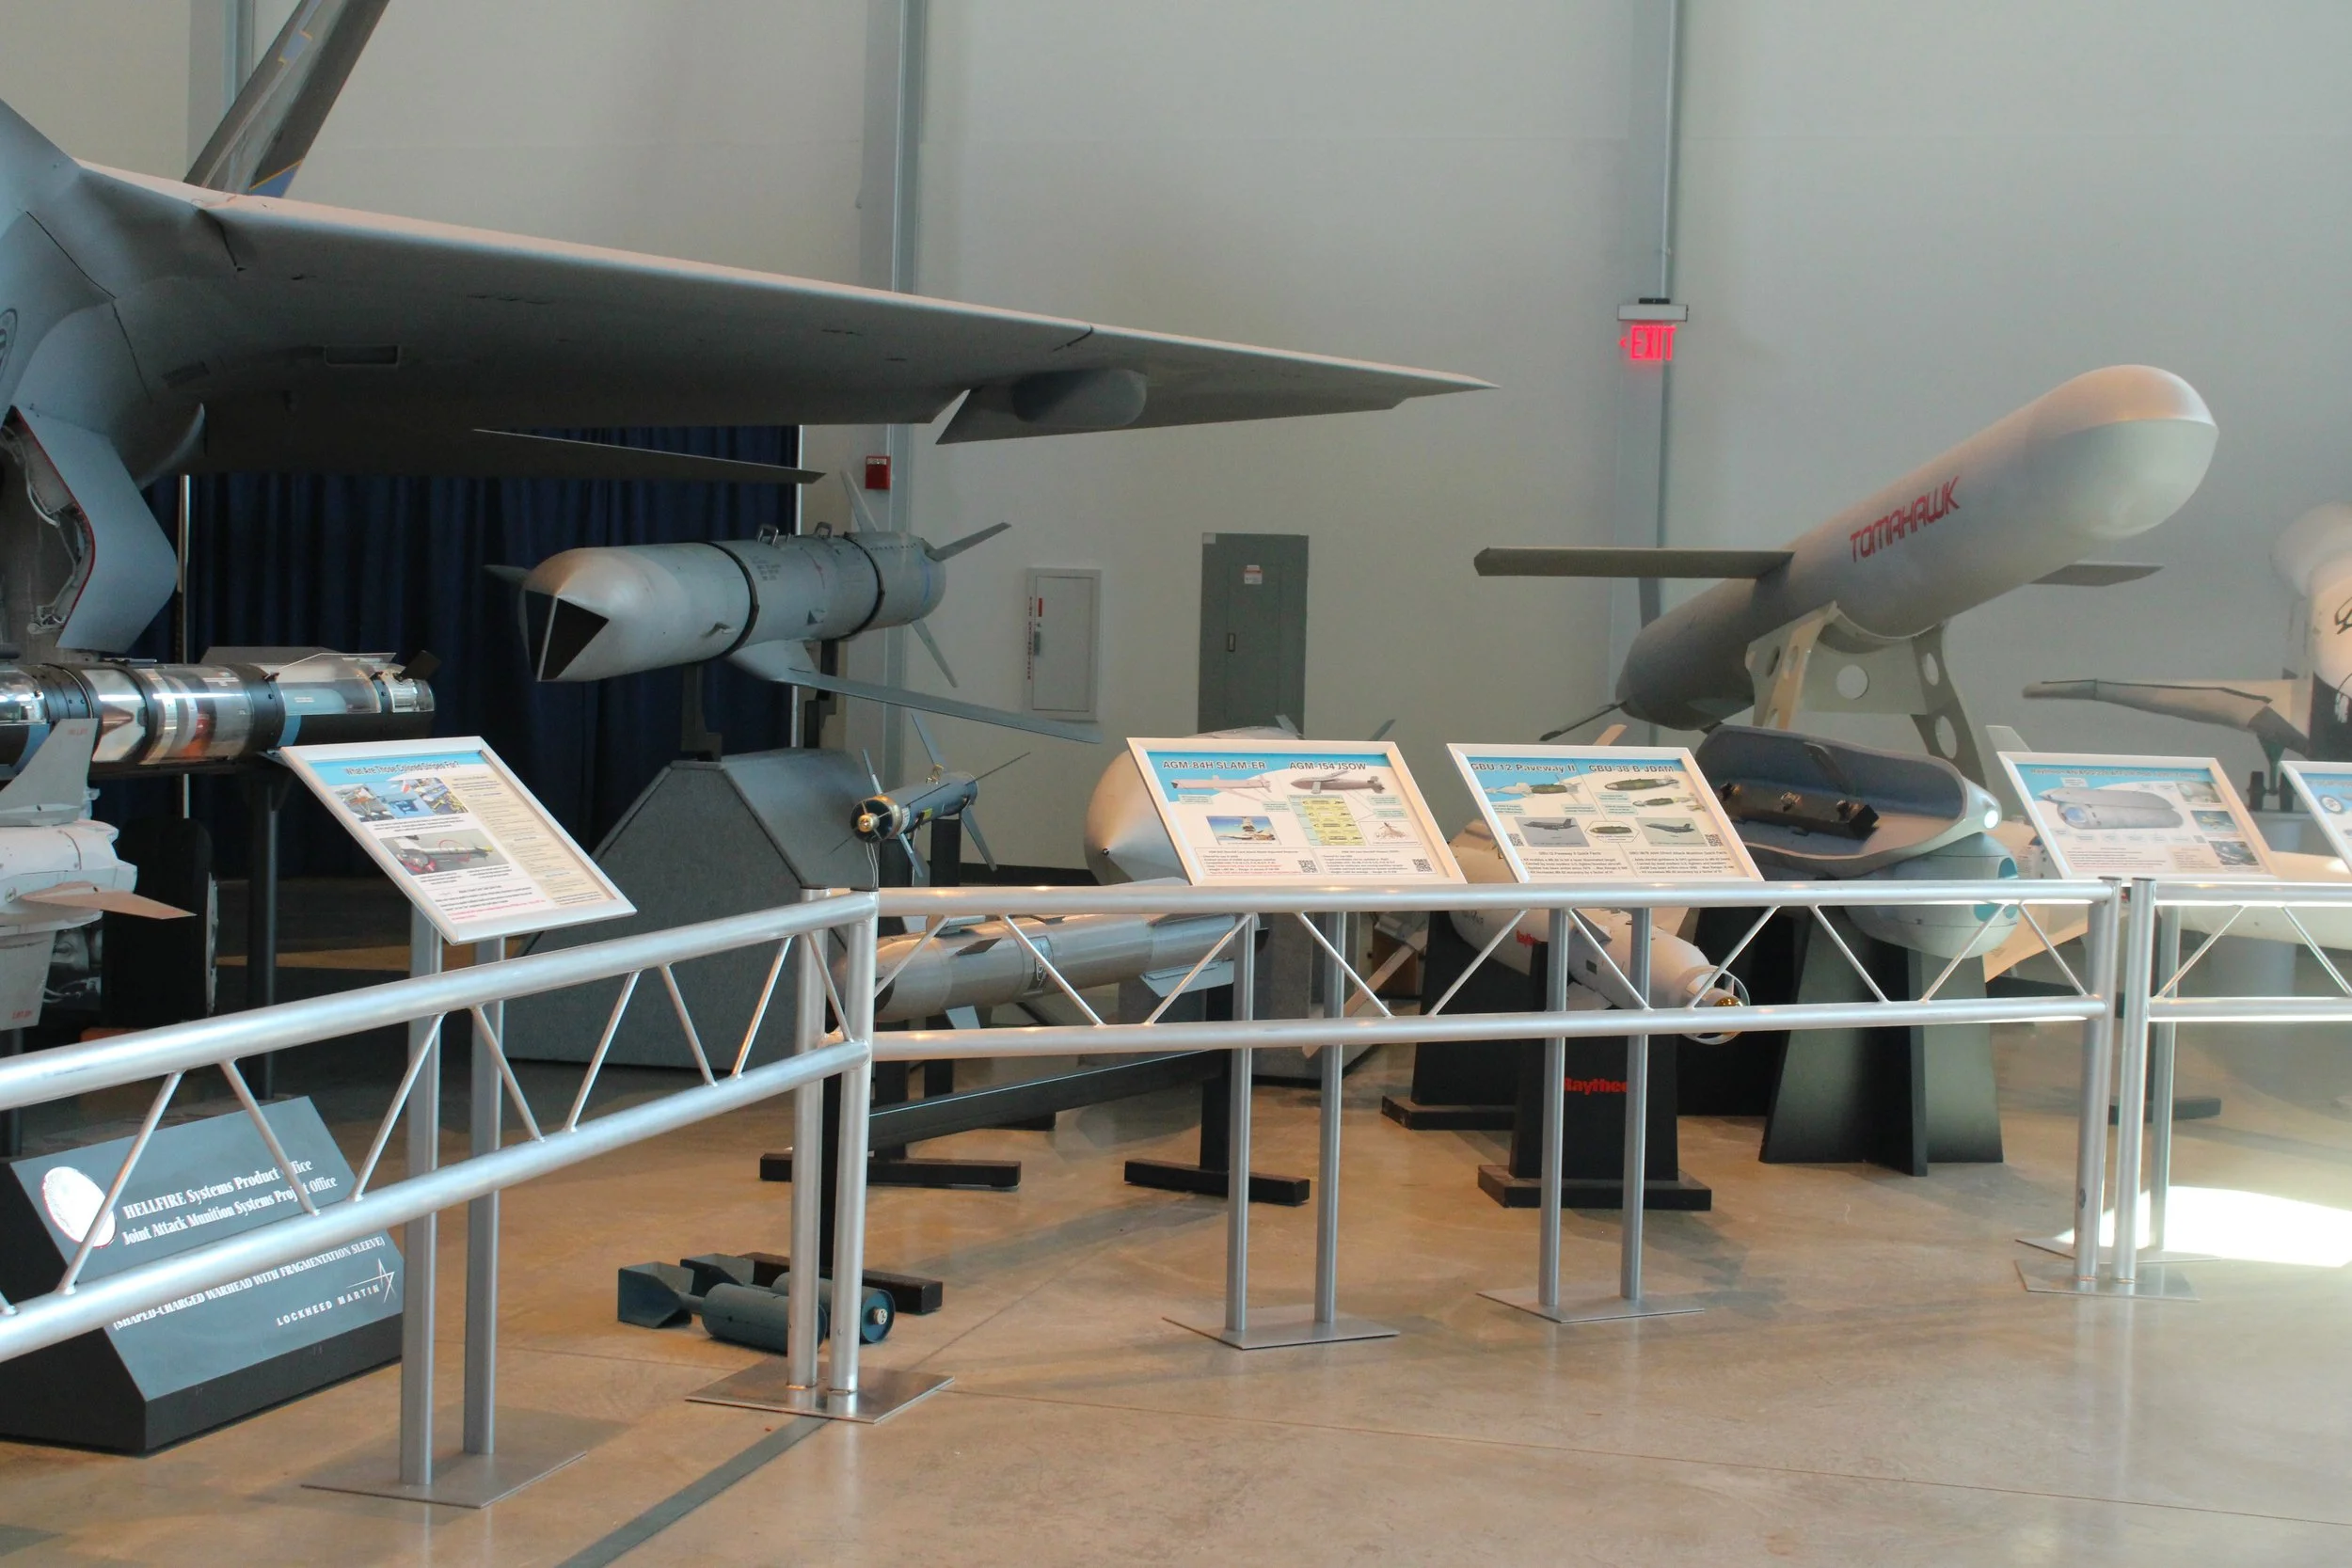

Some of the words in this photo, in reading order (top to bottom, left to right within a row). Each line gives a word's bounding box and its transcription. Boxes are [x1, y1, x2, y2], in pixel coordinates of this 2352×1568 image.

[1629, 325, 1677, 361] EXIT
[1850, 475, 1960, 562] TOMAHAWK
[1163, 760, 1214, 769] AGM-84H
[1216, 761, 1266, 770] SLAM-ER
[1289, 761, 1335, 770] AGM-154
[1337, 762, 1367, 770] JSOW
[1516, 764, 1565, 773] Paveway
[1563, 1077, 1629, 1096] Raythe
[122, 1192, 186, 1219] HELLFIRE
[186, 1180, 235, 1205] Systems
[233, 1166, 280, 1191] Product
[279, 1160, 314, 1180] fice
[121, 1227, 153, 1246] Joint
[151, 1214, 189, 1239] Attack
[186, 1203, 237, 1228] Munition
[234, 1193, 277, 1217] Systems
[273, 1181, 310, 1203] Projt
[309, 1176, 339, 1193] Office
[204, 1277, 254, 1300] WARHEAD
[252, 1270, 279, 1286] WITH
[279, 1246, 352, 1277] FRAGMENTATION
[350, 1236, 386, 1255] SLEEVE)
[277, 1300, 334, 1326] LOCKHEED
[337, 1283, 380, 1306] MARTIN
